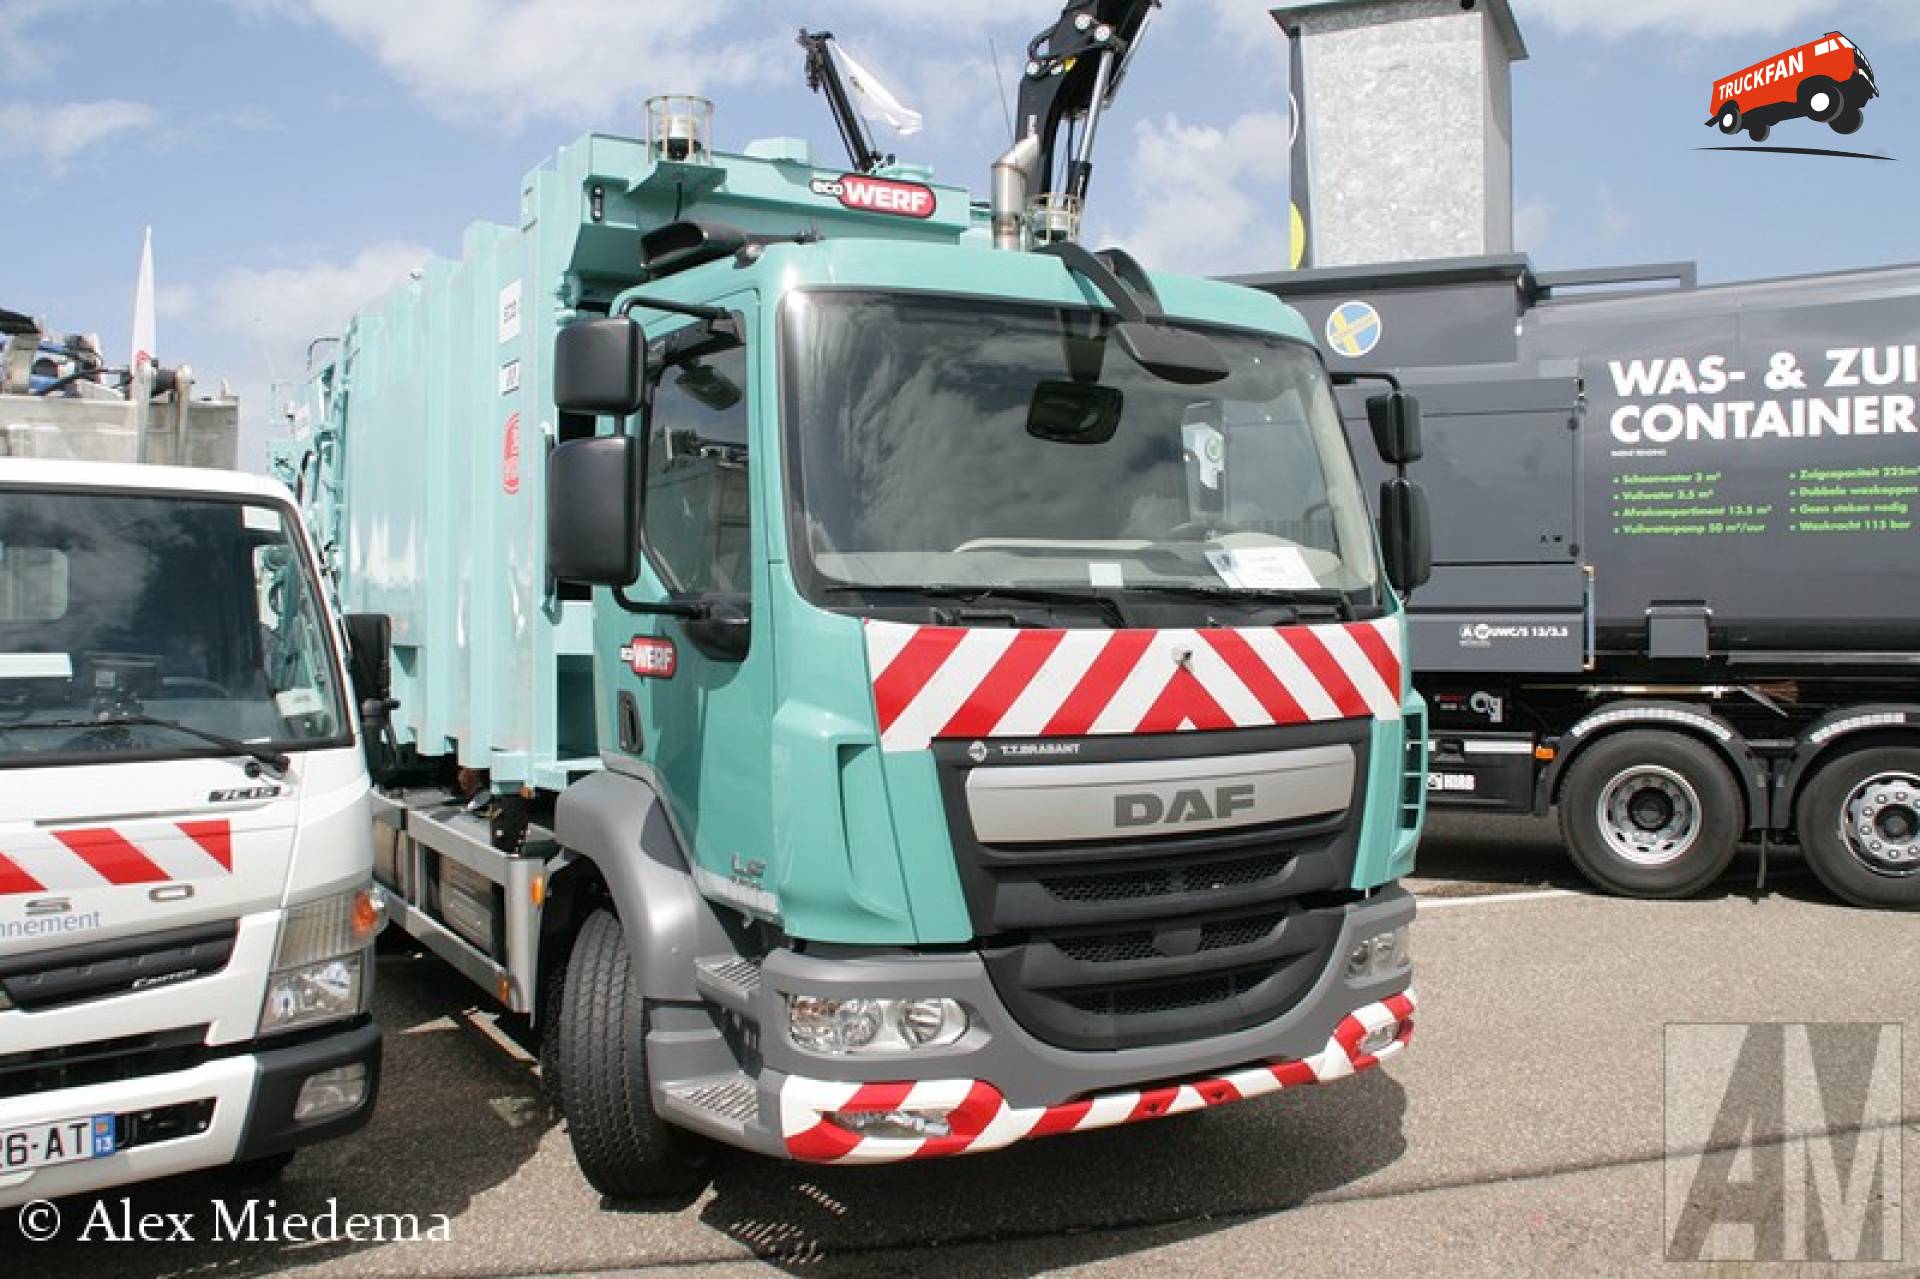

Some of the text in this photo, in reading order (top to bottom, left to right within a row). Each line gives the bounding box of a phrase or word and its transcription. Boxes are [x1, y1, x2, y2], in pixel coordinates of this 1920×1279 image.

[845, 181, 928, 212] WERF
[1608, 345, 1918, 396] WAS- & ZUI
[1610, 395, 1919, 443] CONTAINER
[1113, 784, 1256, 828] DAF
[0, 1122, 89, 1168] 6-AT
